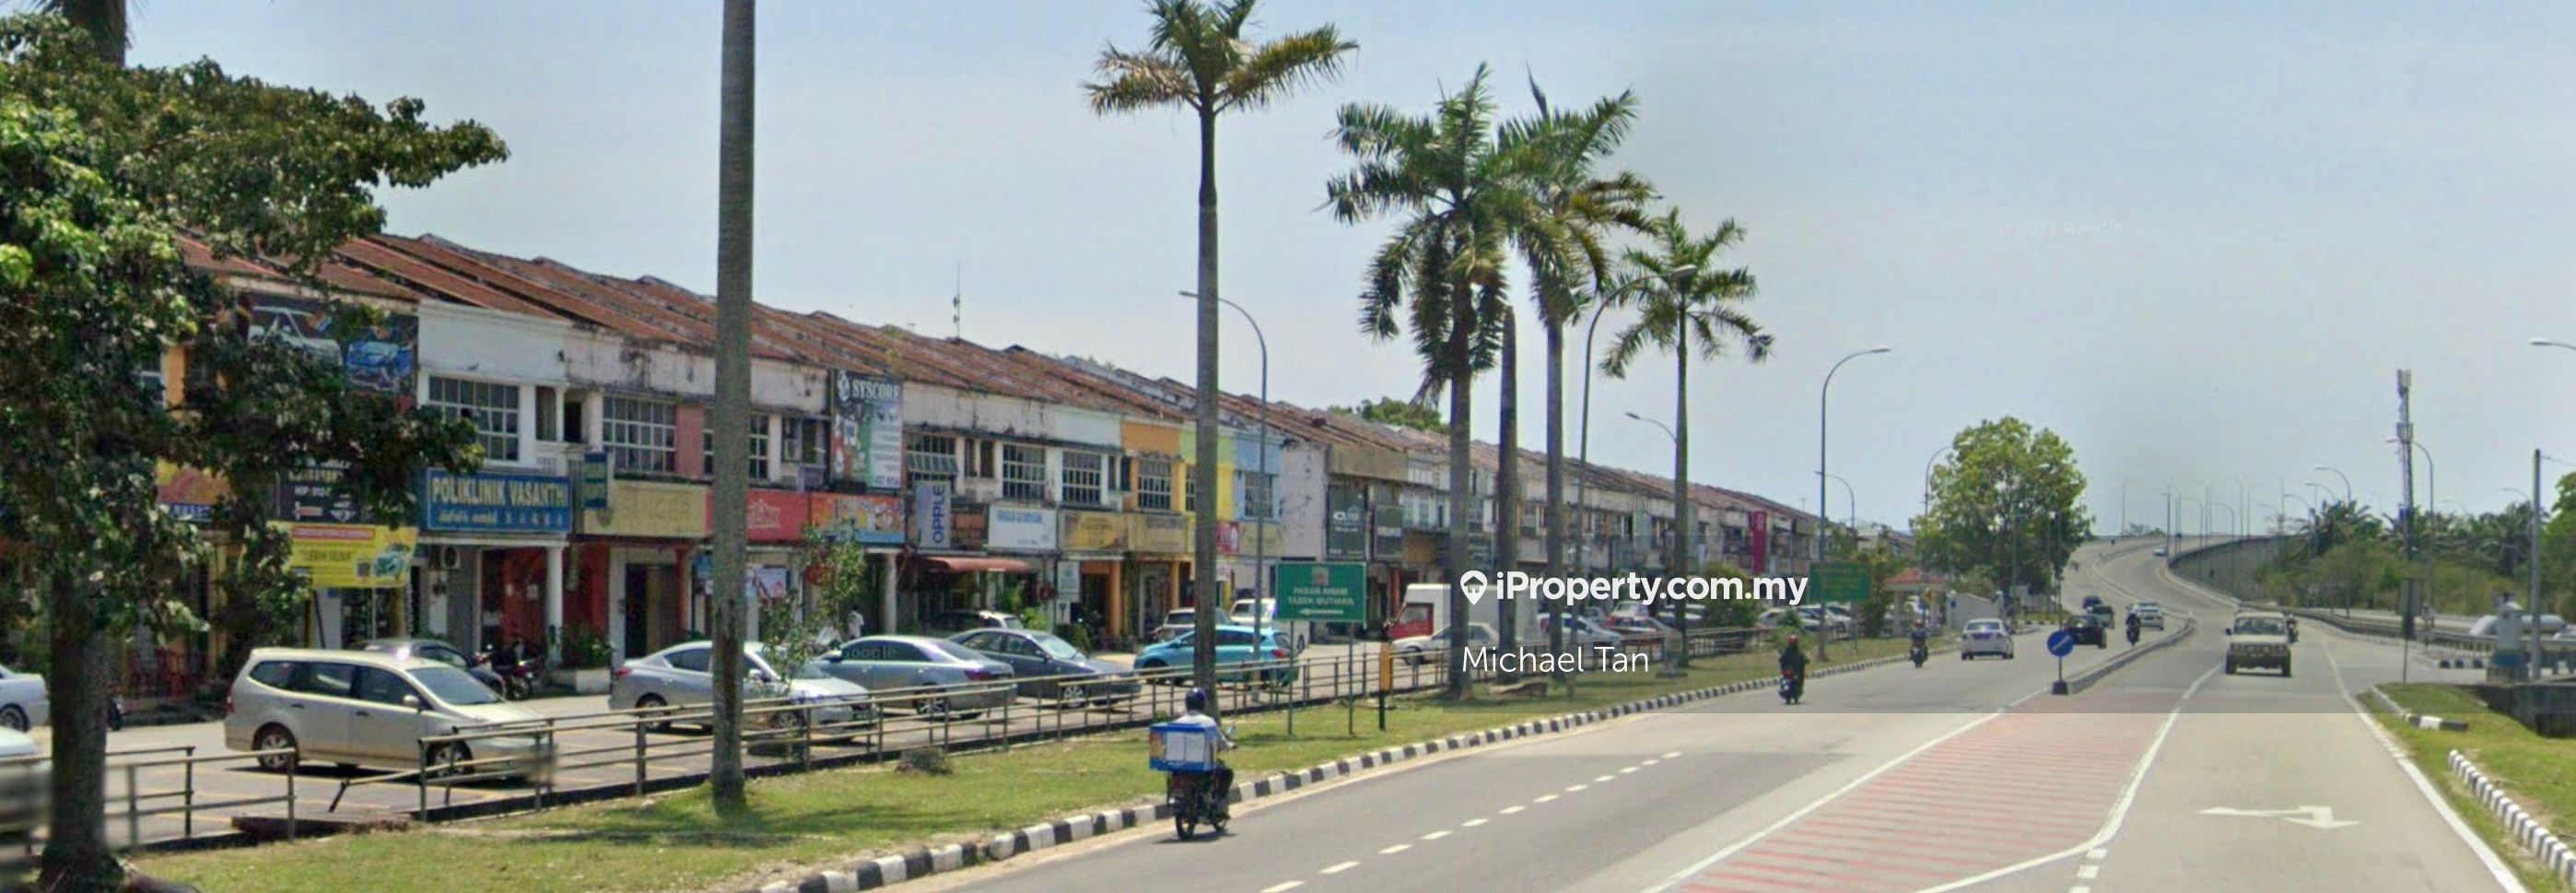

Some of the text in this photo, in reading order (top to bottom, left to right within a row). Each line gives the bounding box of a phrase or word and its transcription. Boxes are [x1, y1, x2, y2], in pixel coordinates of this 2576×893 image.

[431, 476, 568, 508] POLIKLINIK VASANTHI
[932, 485, 945, 544] OPPLE
